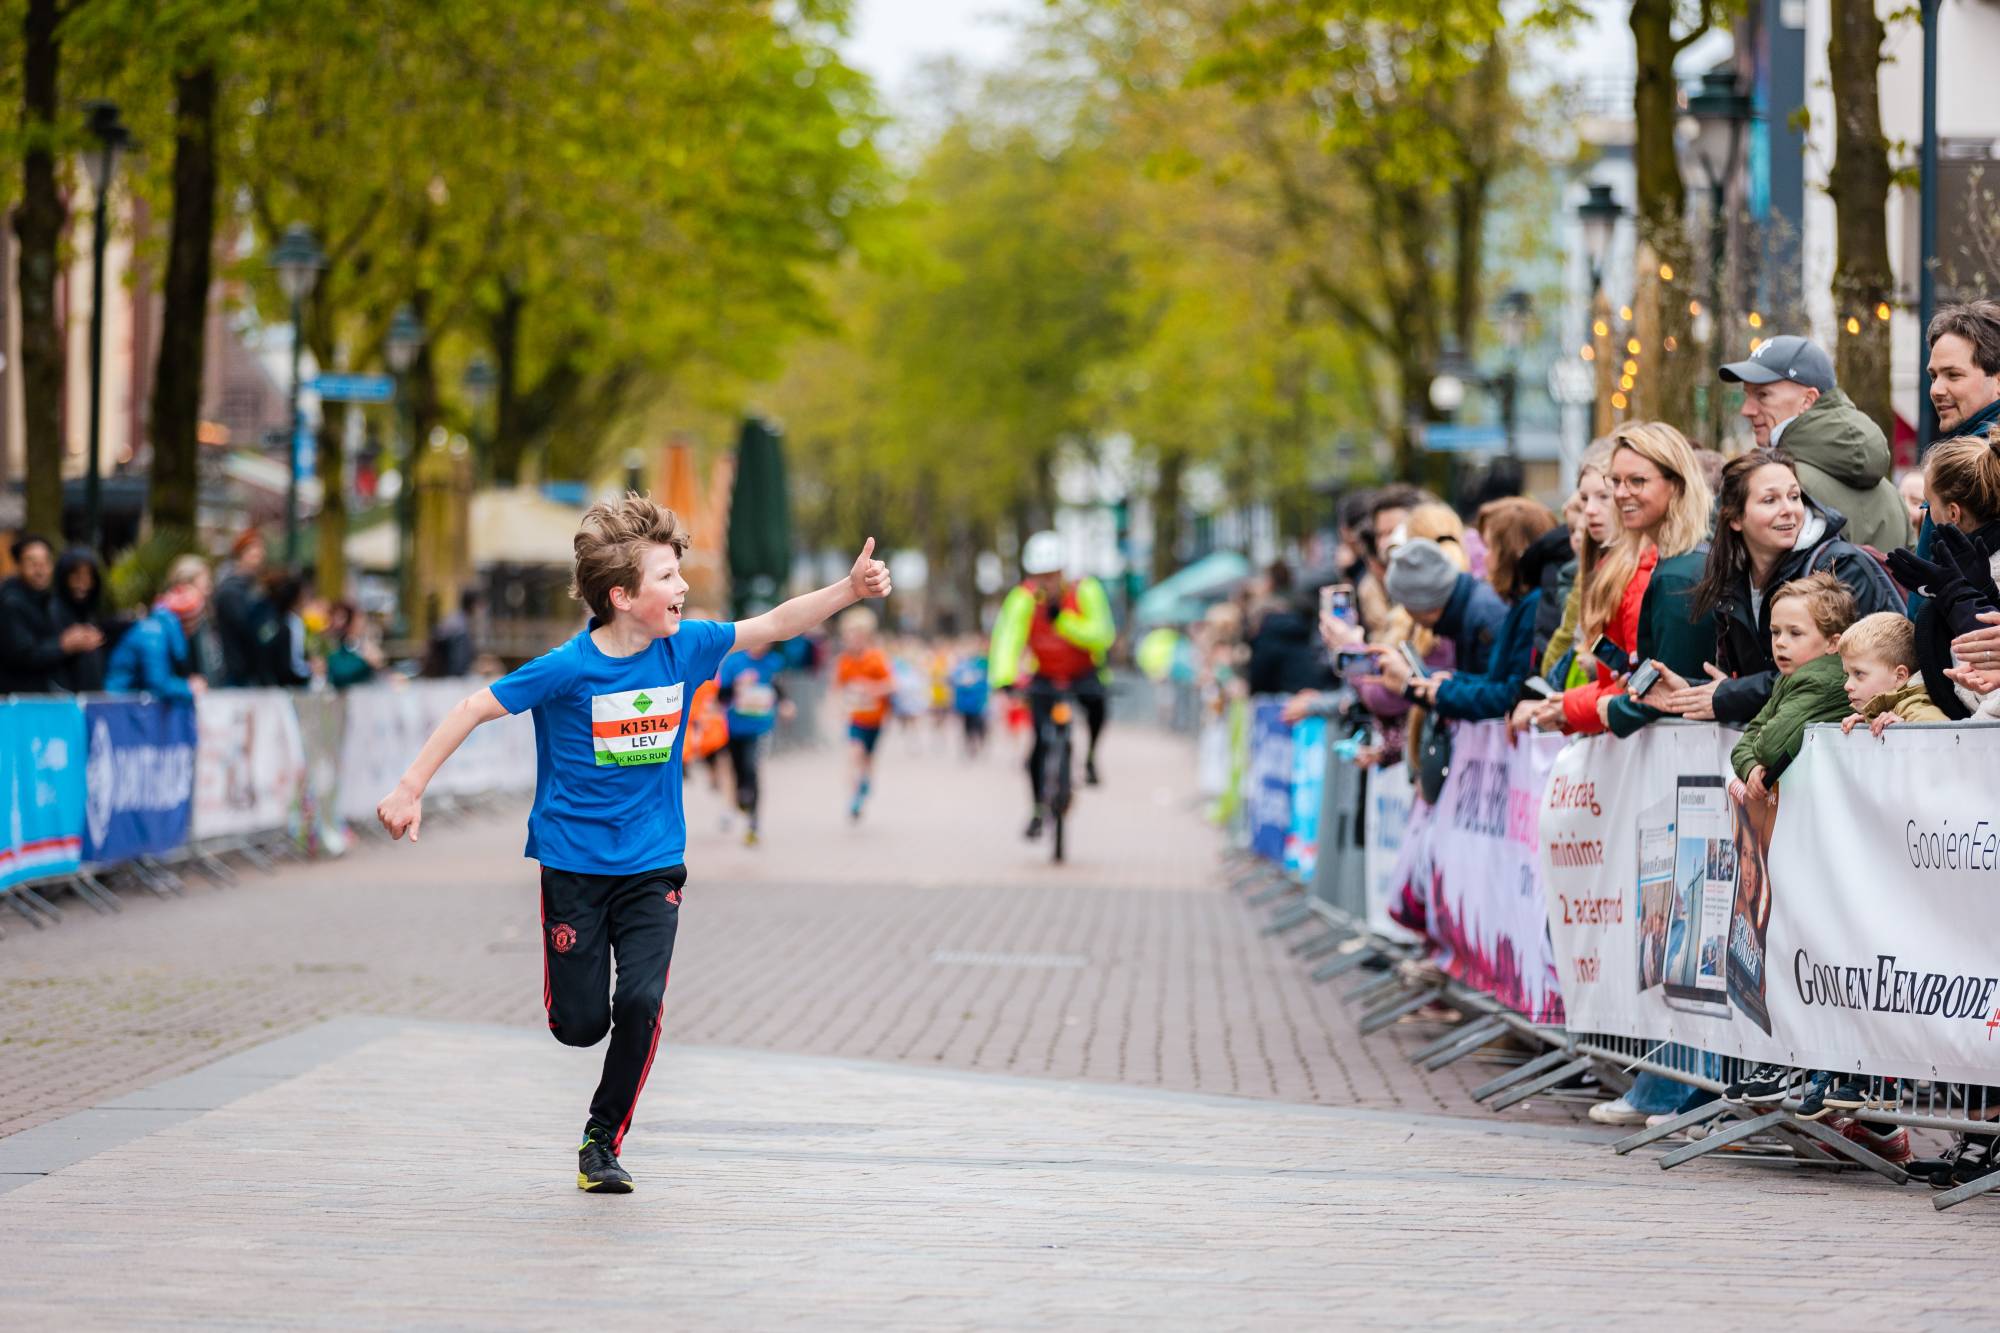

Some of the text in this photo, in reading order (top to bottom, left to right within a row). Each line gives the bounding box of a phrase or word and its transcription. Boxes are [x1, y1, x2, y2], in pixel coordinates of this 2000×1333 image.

[620, 718, 668, 735] K1514
[632, 735, 657, 748] LEV
[627, 754, 647, 762] KIDS
[649, 751, 667, 760] RUN
[1906, 819, 2000, 871] GooienEe
[1559, 893, 1572, 925] 2
